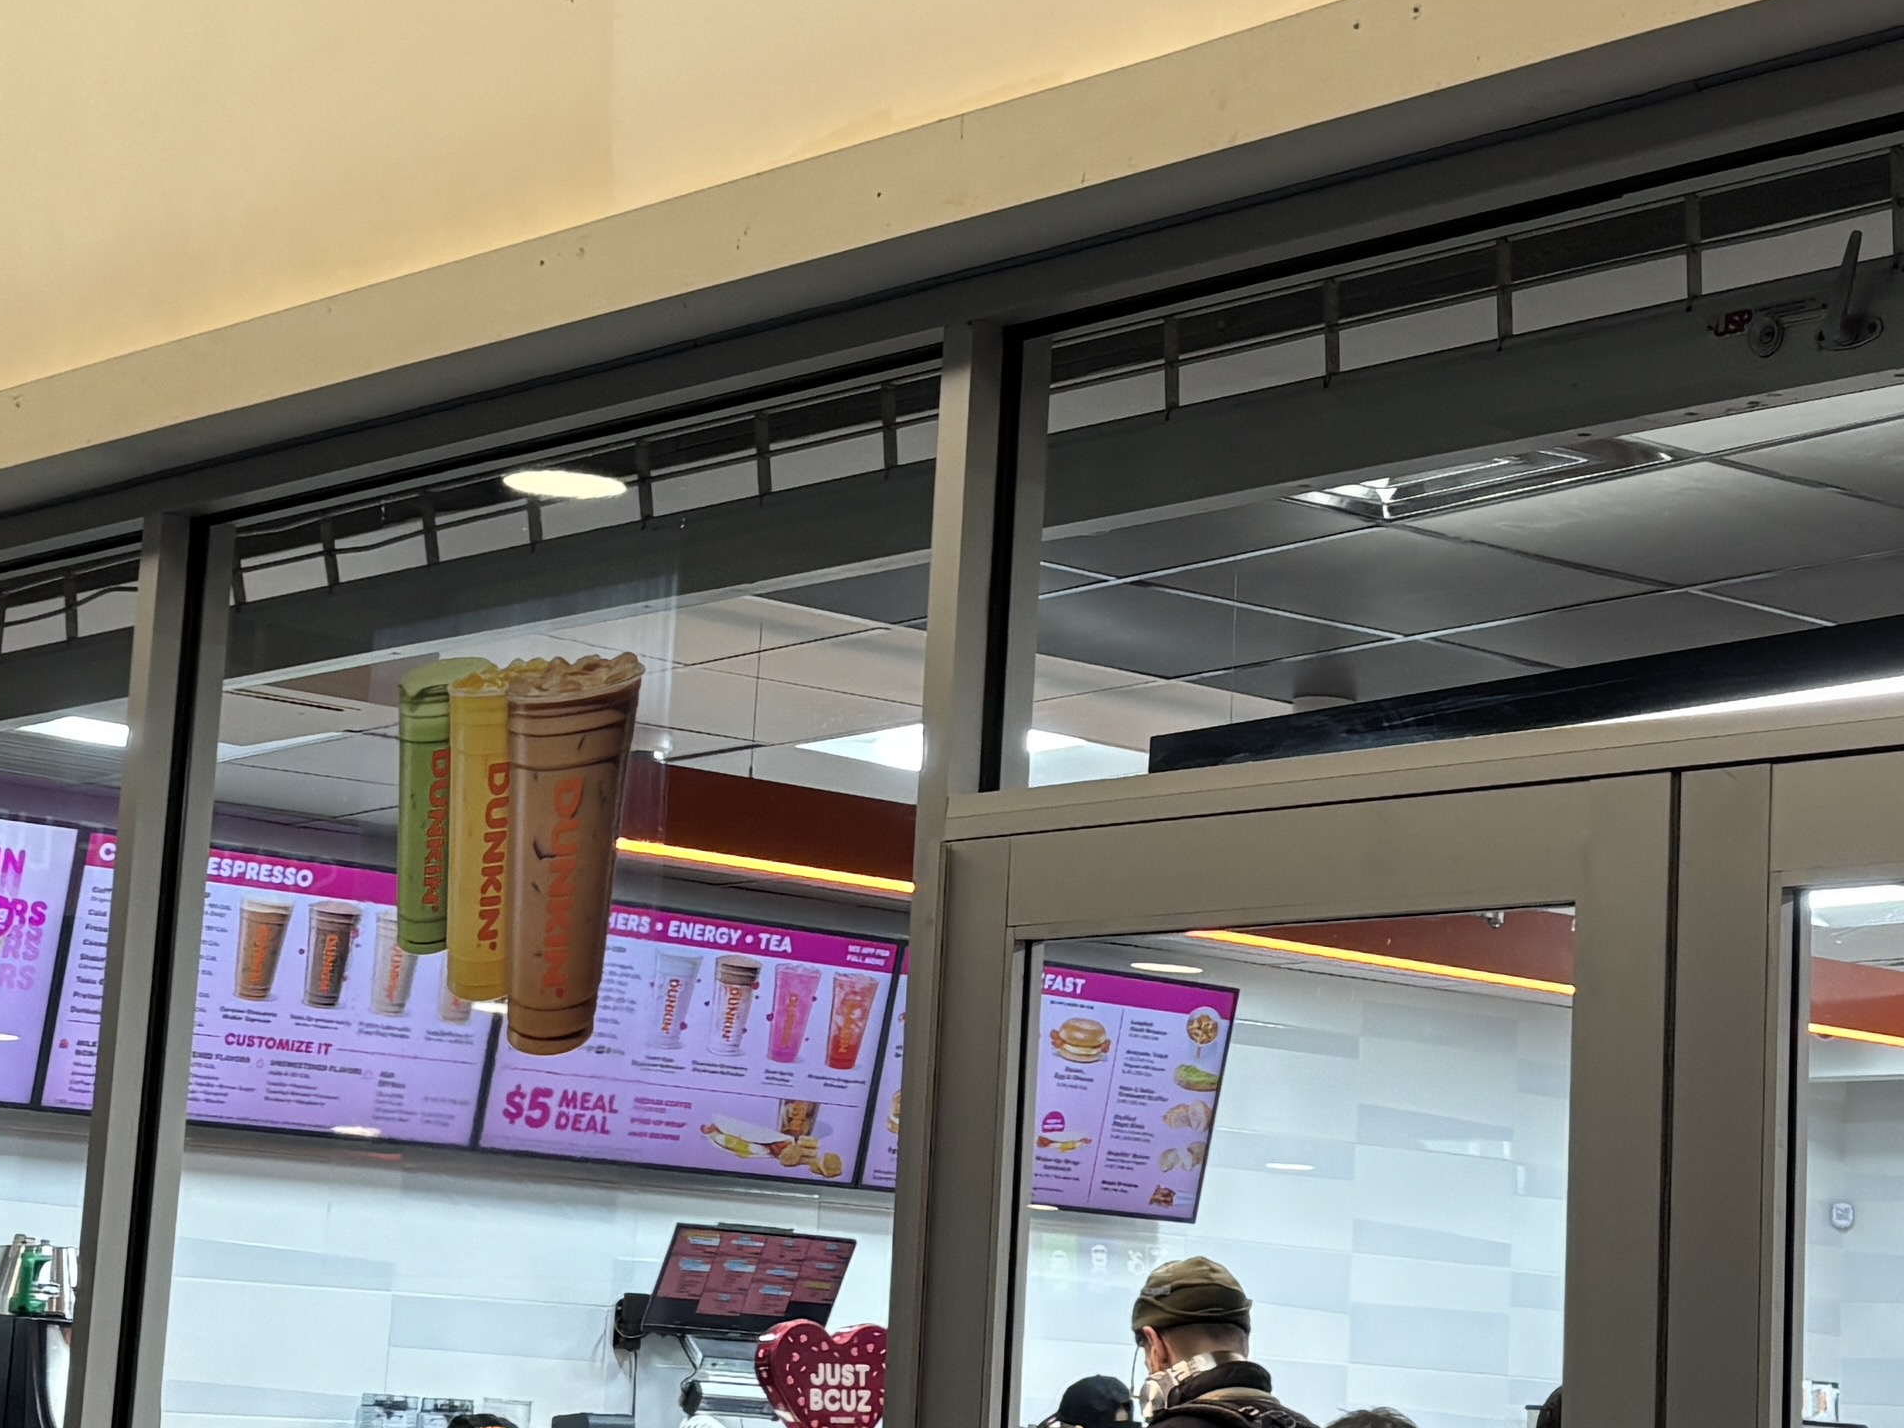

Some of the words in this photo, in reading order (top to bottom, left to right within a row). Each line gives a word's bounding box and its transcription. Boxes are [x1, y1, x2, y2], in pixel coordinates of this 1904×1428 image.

[476, 762, 511, 952] DUNKIN'
[207, 857, 313, 888] ESPRESSO
[539, 776, 584, 1000] DUNKIN'
[667, 920, 741, 946] ENERGY
[758, 932, 792, 954] TEA
[1043, 973, 1085, 994] FAST
[224, 1033, 314, 1054] CUSTOMIZE
[318, 1041, 333, 1056] IT
[503, 1084, 553, 1129] $5
[558, 1089, 618, 1114] MEAL
[555, 1112, 610, 1135] DEAL
[810, 1362, 871, 1387] JUST
[809, 1387, 872, 1413] BCUZ
